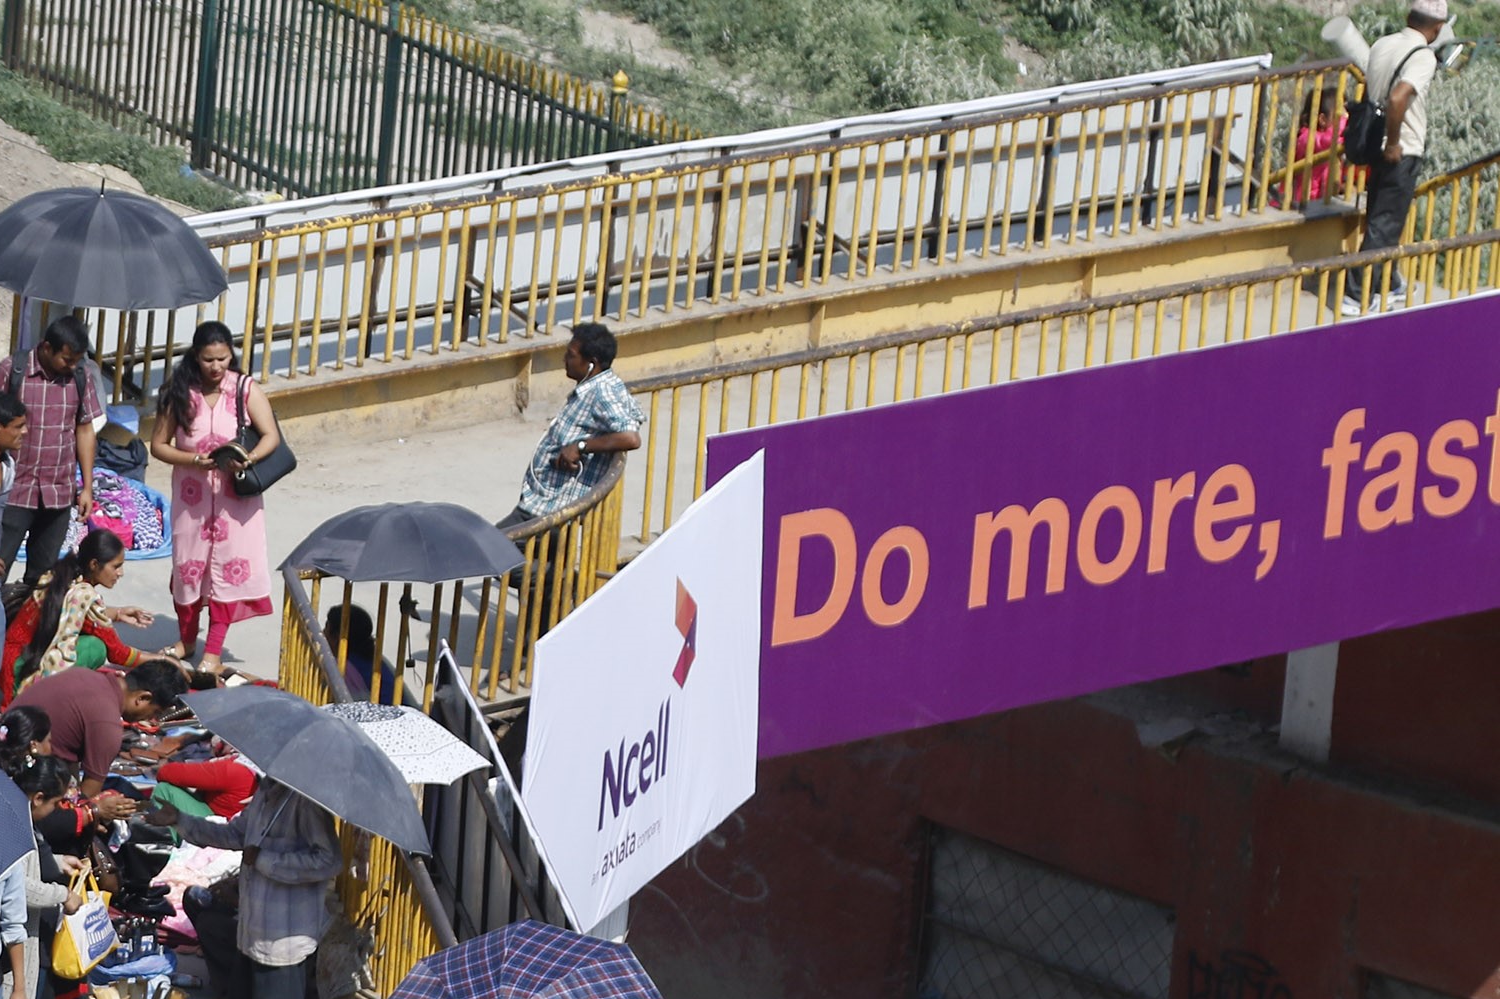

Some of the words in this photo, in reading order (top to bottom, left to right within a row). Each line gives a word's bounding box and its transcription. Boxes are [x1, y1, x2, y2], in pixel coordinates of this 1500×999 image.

[771, 507, 930, 647] Do
[968, 463, 1282, 611] more,
[597, 693, 672, 832] Ncell
[601, 828, 636, 877] axiata
